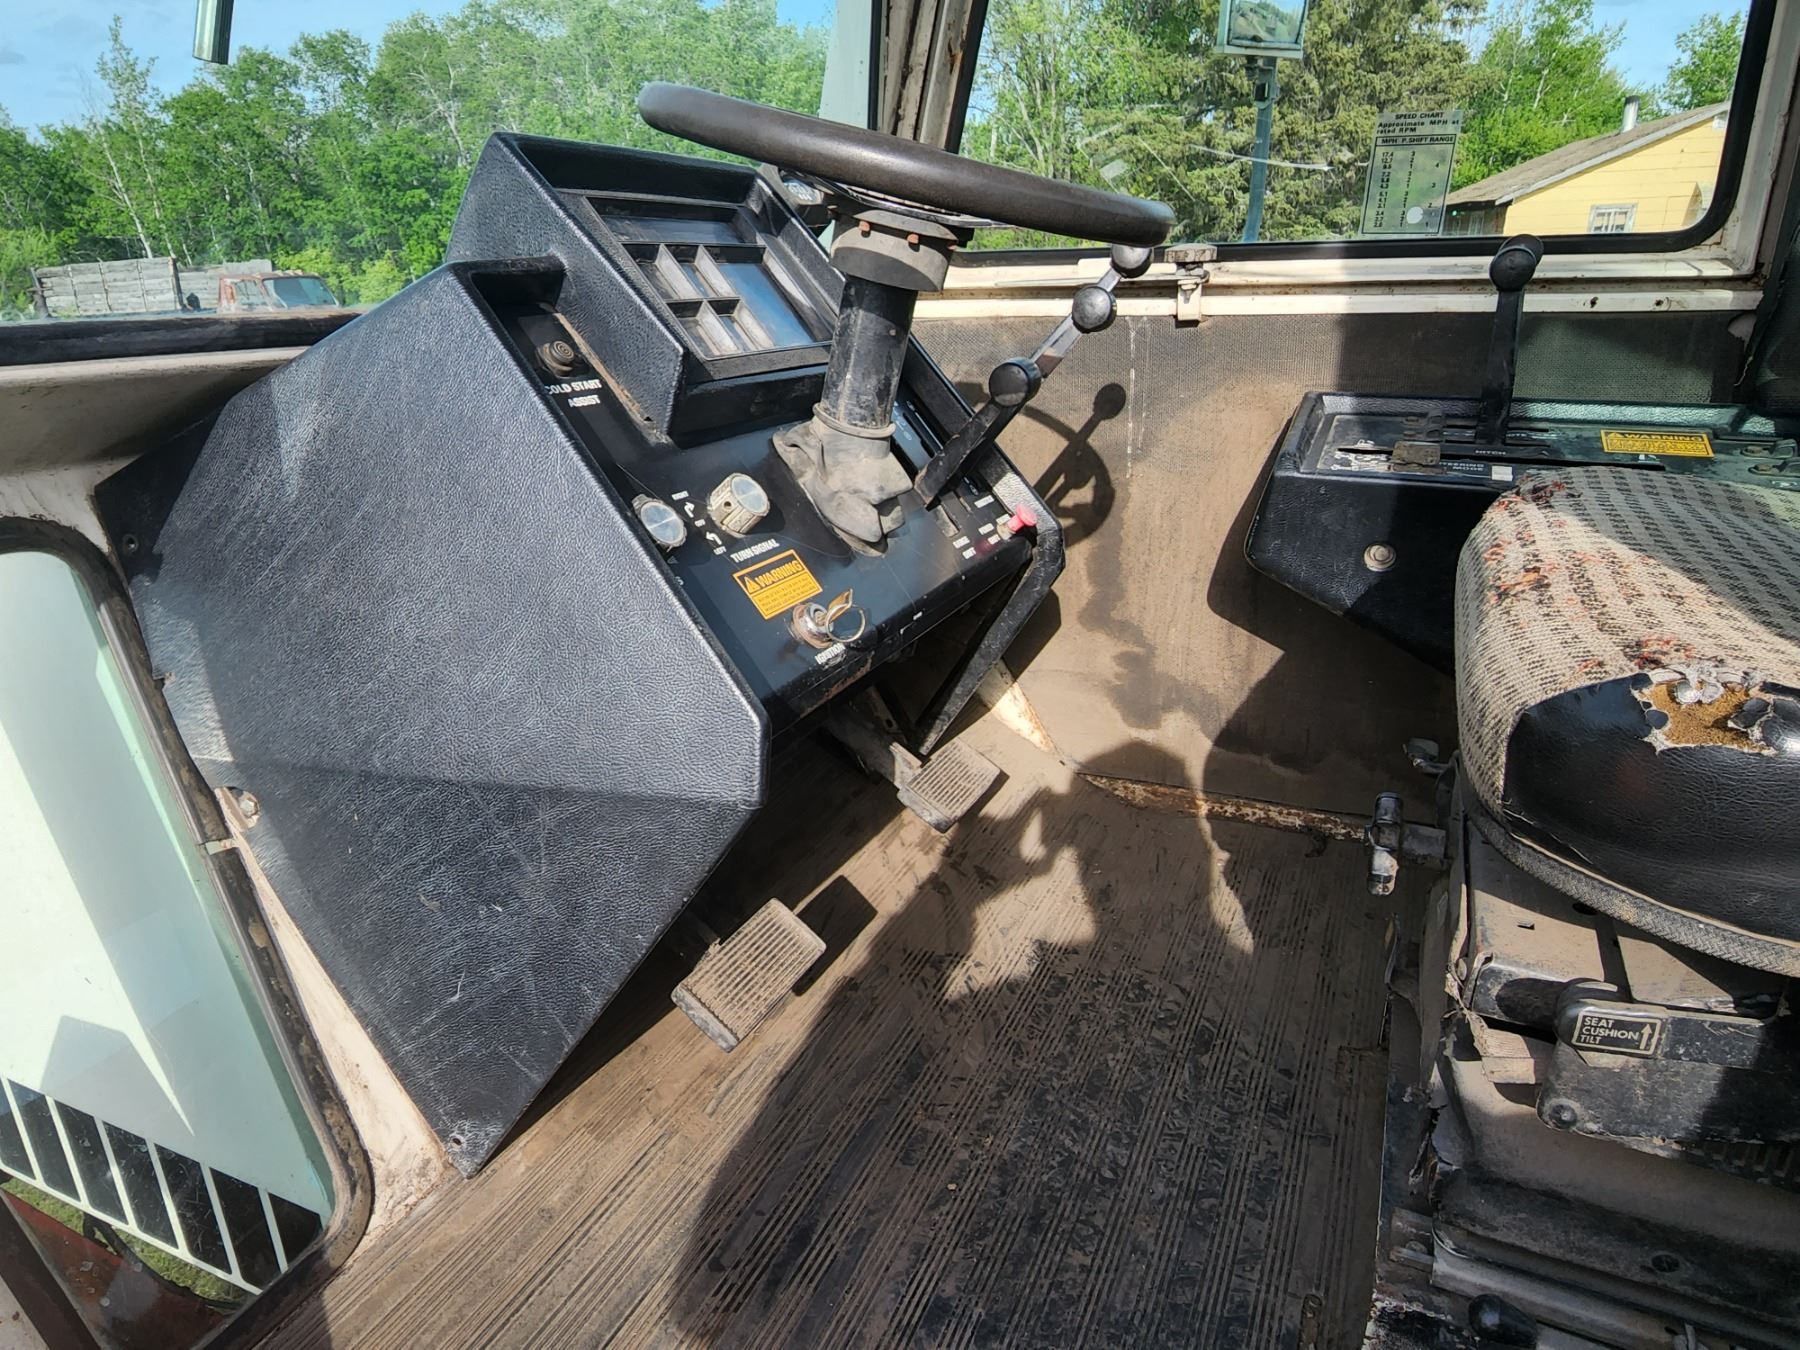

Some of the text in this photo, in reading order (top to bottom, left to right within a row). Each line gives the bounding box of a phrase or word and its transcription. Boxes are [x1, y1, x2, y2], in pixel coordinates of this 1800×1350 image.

[1378, 121, 1425, 129] Approximate
[571, 379, 602, 391] START
[568, 394, 601, 408] ASSIST
[1625, 433, 1703, 442] WARNING
[730, 538, 780, 563] TURN SIGNAL
[754, 559, 803, 588] WARNING
[815, 642, 846, 665] IGNITION
[1584, 1016, 1614, 1028] SEAT
[1580, 1034, 1602, 1045] TILT
[1582, 1026, 1639, 1041] CUSHION
